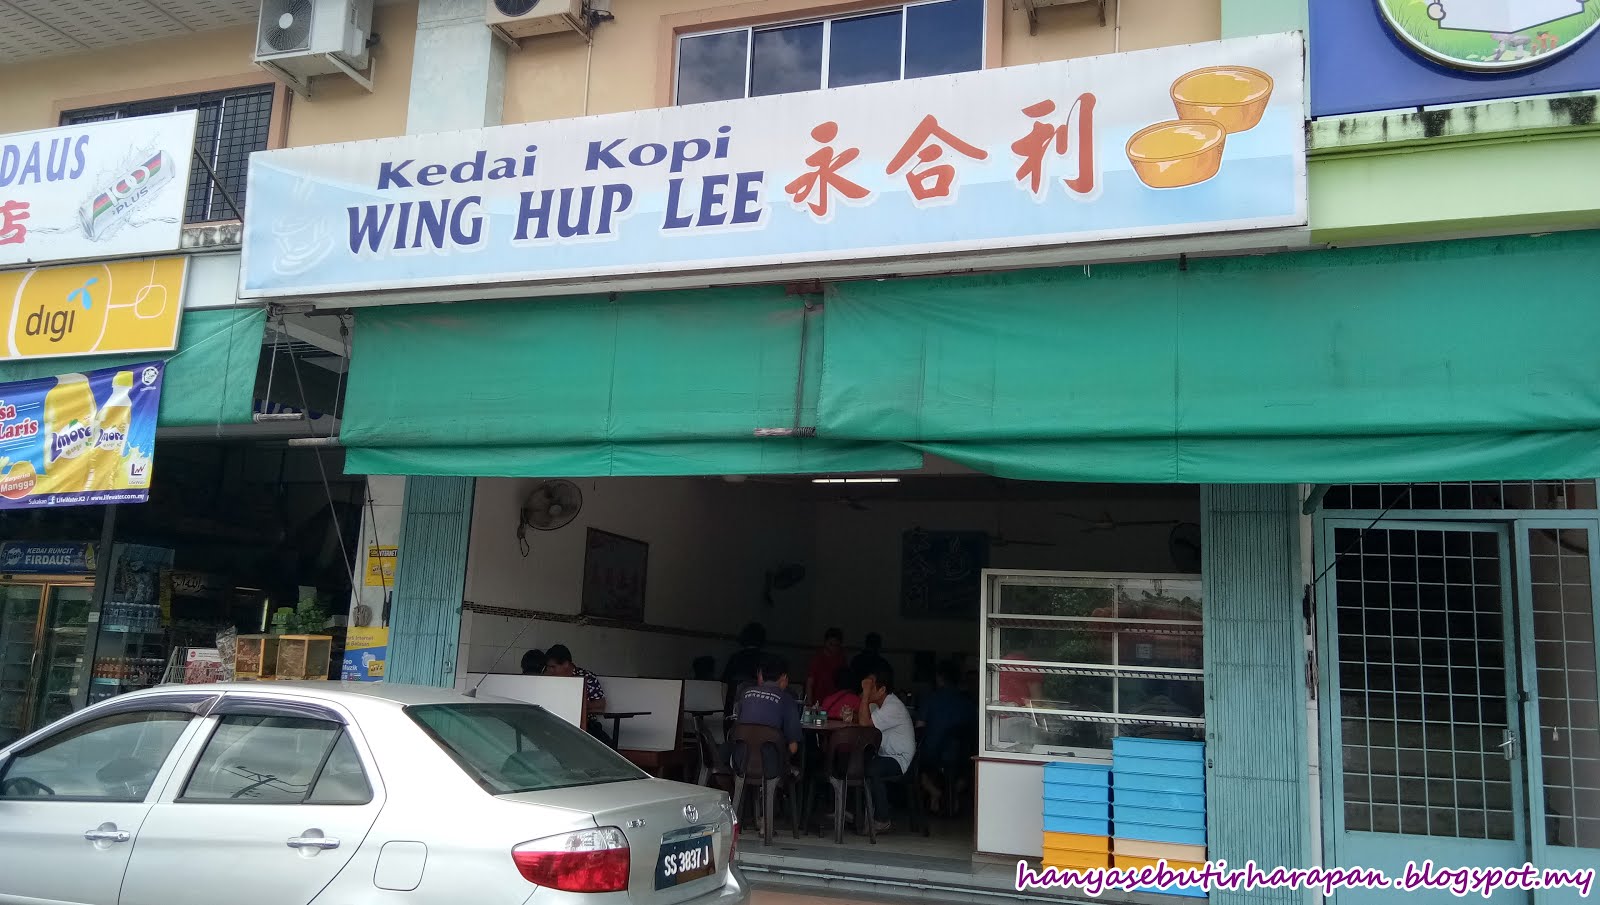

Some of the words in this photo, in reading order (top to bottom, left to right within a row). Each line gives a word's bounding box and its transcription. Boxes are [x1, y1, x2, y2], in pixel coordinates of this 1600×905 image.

[377, 145, 538, 190] Kedai
[585, 125, 732, 173] Kopi
[784, 92, 1097, 216] 永合利
[115, 186, 149, 214] PLUS
[347, 195, 484, 254] WING
[513, 183, 633, 241] HUP
[662, 171, 764, 229] LEE
[25, 304, 76, 342] digi
[0, 479, 34, 493] Mangga
[24, 555, 71, 565] FIRDAUS
[664, 854, 678, 877] SS
[678, 847, 701, 873] 3837
[703, 845, 709, 866] J
